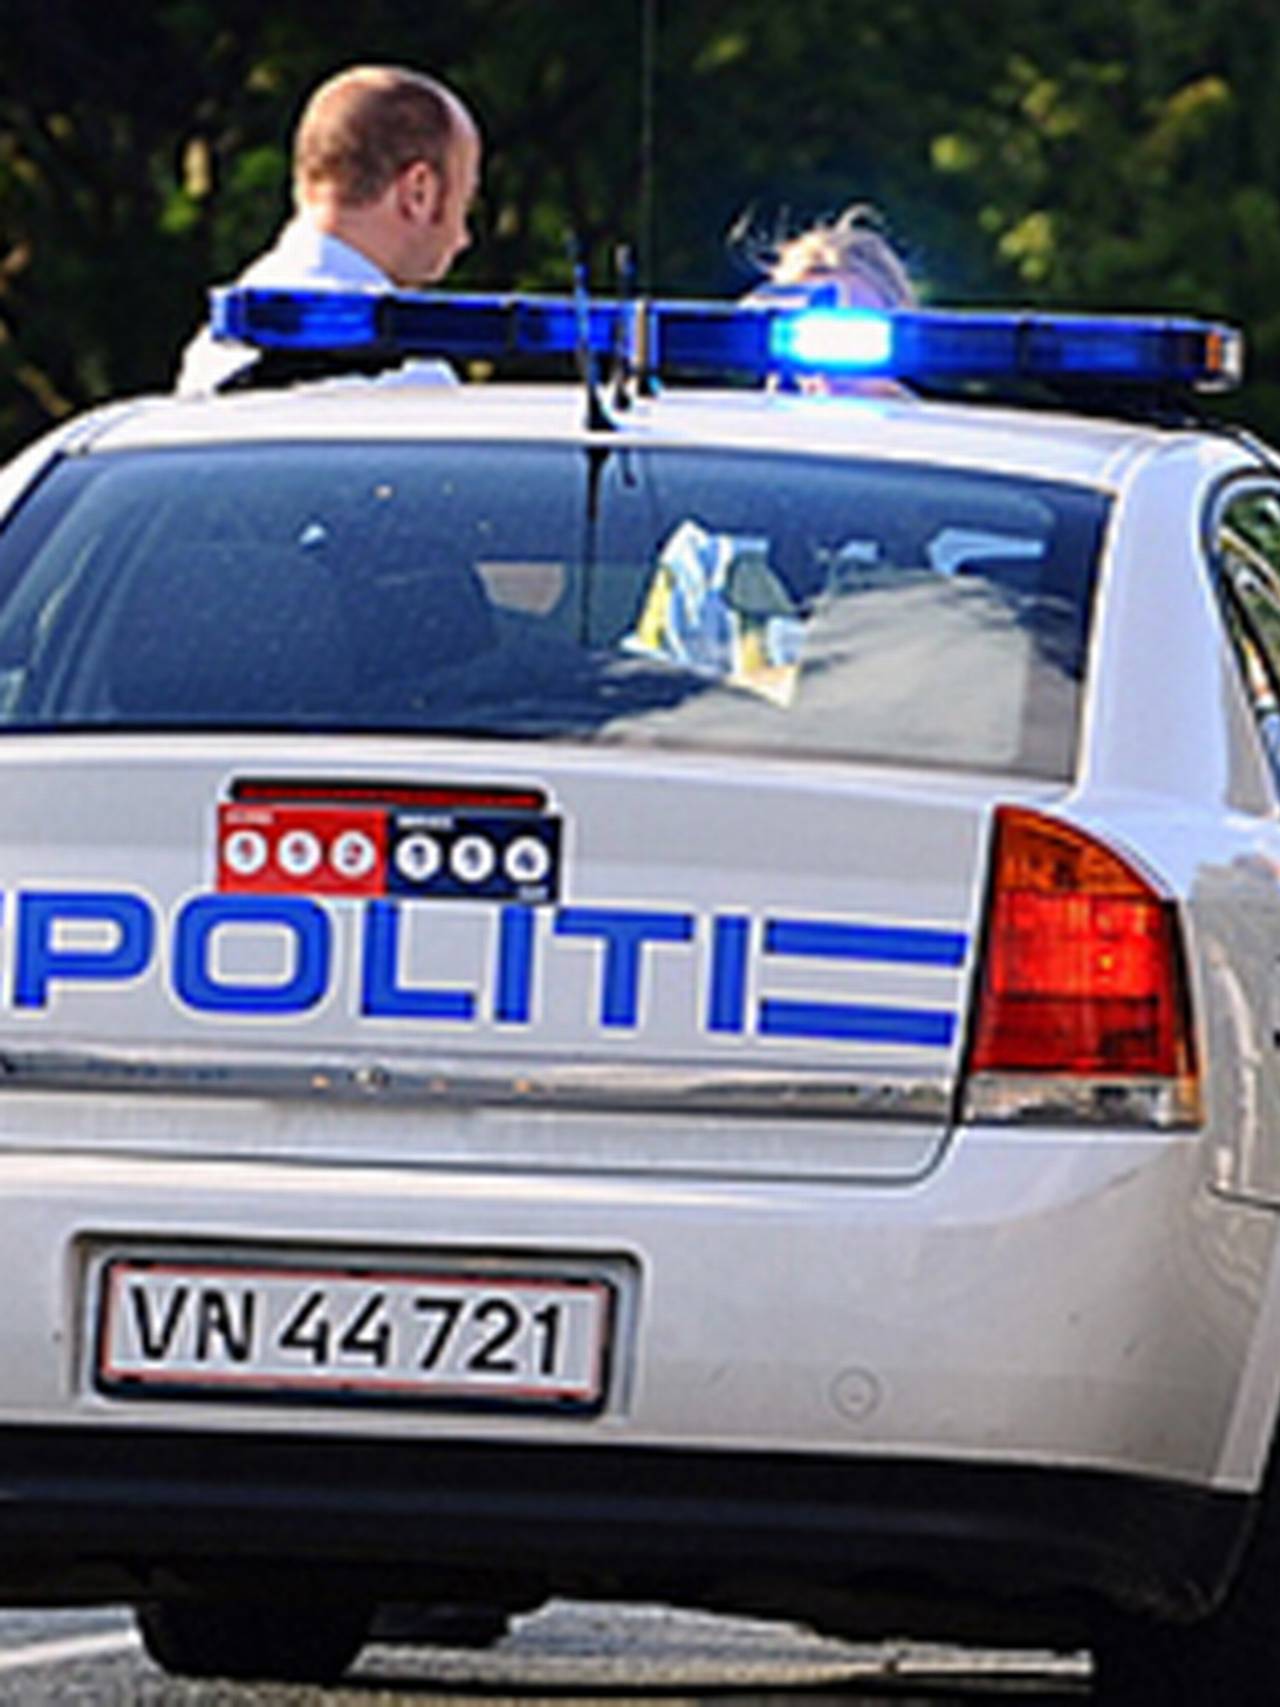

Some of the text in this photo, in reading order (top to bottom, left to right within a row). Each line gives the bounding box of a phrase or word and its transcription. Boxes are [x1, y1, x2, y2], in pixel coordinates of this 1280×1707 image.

[12, 889, 751, 1033] POLITI
[131, 1285, 562, 1377] VN 44 721
